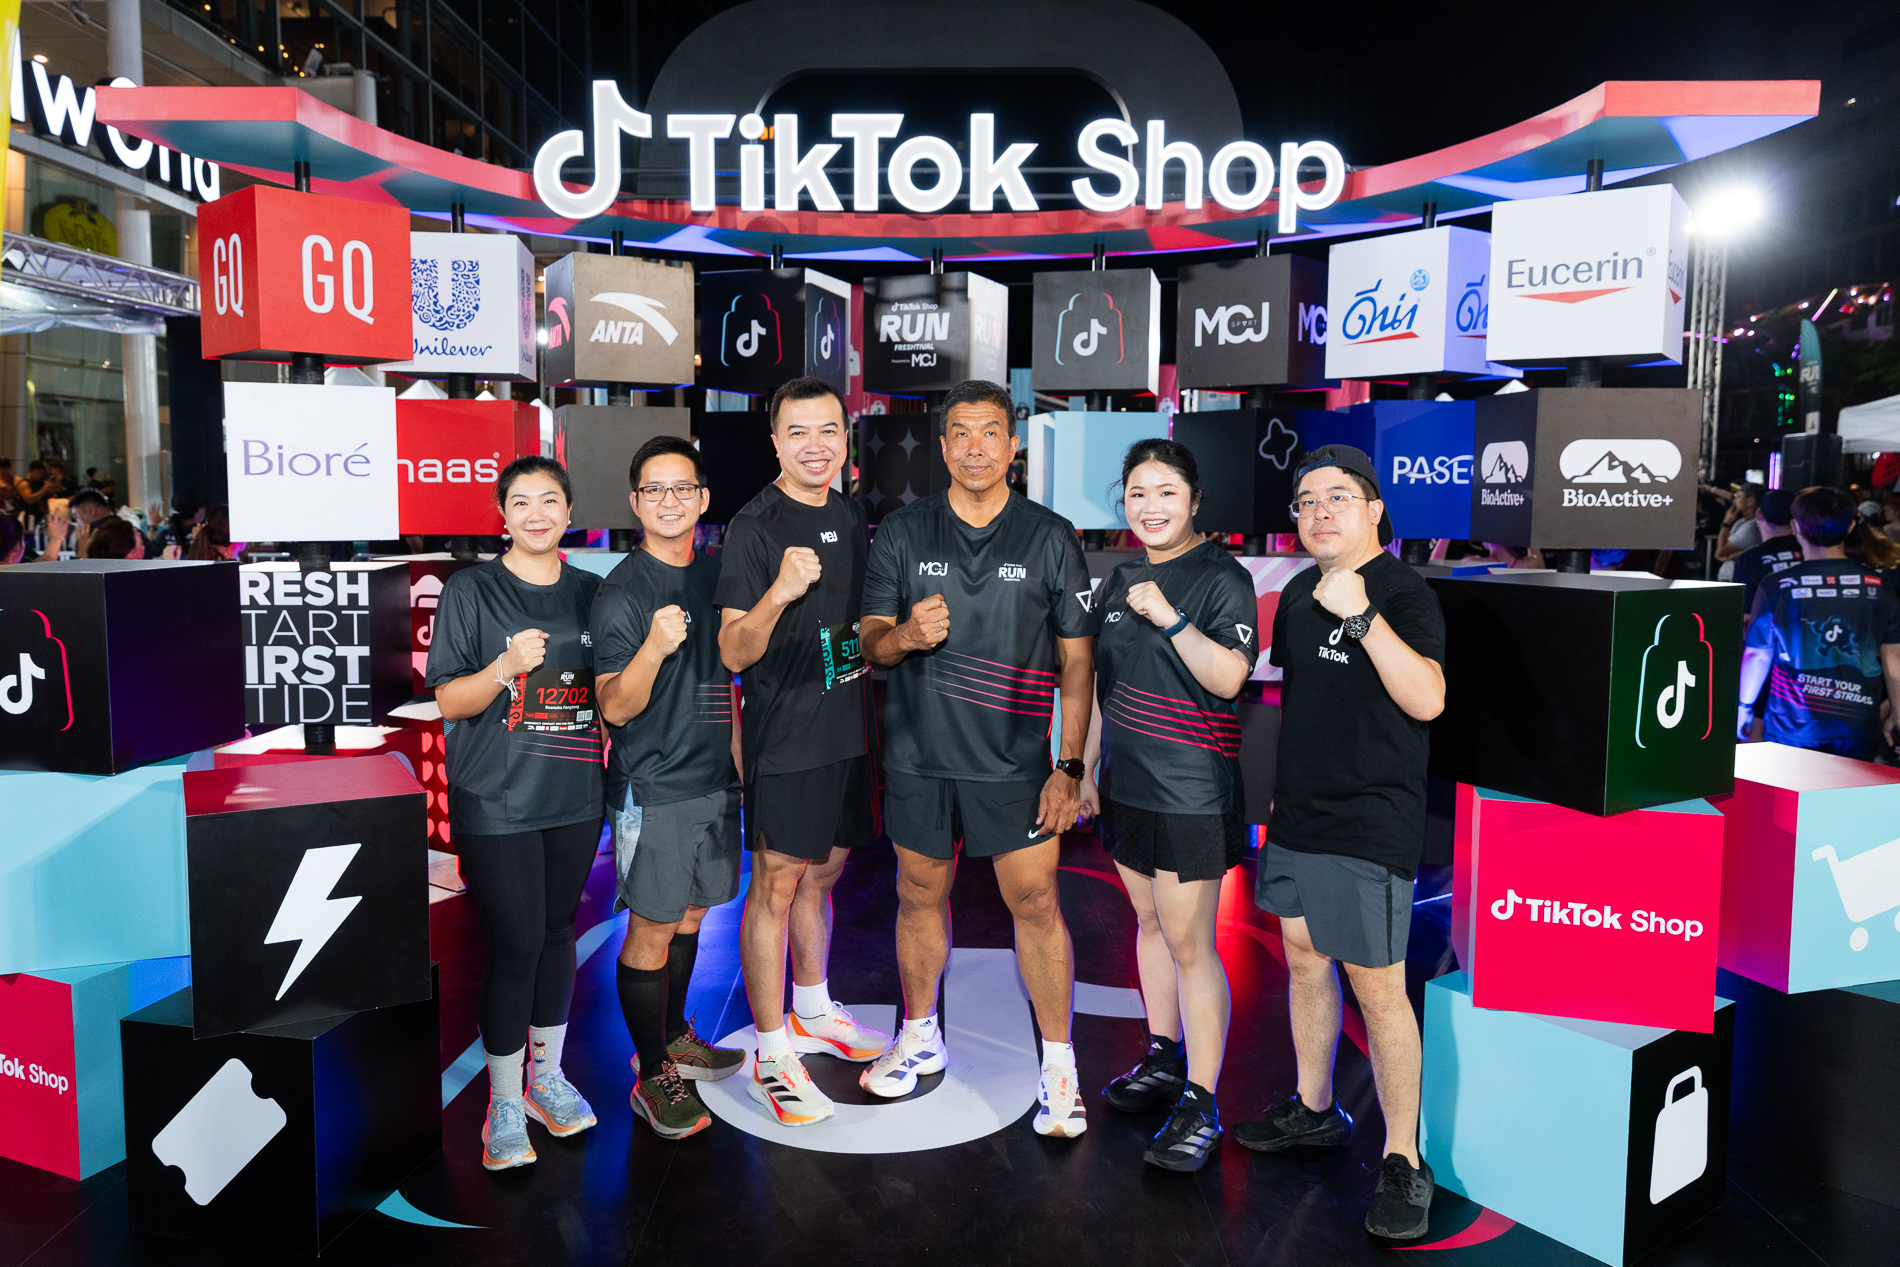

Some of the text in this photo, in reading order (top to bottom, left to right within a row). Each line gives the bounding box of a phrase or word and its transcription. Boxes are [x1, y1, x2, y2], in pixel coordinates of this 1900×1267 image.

[666, 113, 1346, 234] TikTok Shop
[213, 233, 244, 318] GQ
[301, 235, 375, 325] GQ
[900, 302, 938, 311] TikTok Shop
[589, 320, 644, 345] ANTA
[879, 312, 950, 342] RUN
[1195, 302, 1270, 347] MCJ
[1298, 302, 1328, 345] MC
[894, 343, 934, 351] FRESHTIVAL
[911, 353, 937, 367] MCJ
[242, 440, 371, 478] Bioré
[1392, 454, 1474, 485] PASE
[1481, 488, 1525, 506] BioActive+
[1562, 488, 1673, 507] BioActive+
[919, 562, 948, 576] MCJ
[998, 566, 1027, 578] RUN
[240, 571, 370, 607] RESH
[241, 610, 370, 645] TART
[245, 645, 370, 684] IRST
[1318, 646, 1349, 664] TikTok
[536, 687, 588, 705] 12702
[1797, 673, 1862, 693] START YOUR
[1802, 684, 1834, 698] FIRST
[245, 684, 371, 723] TIDE
[1526, 897, 1703, 942] TikTok Shop
[29, 1063, 69, 1095] Shop
